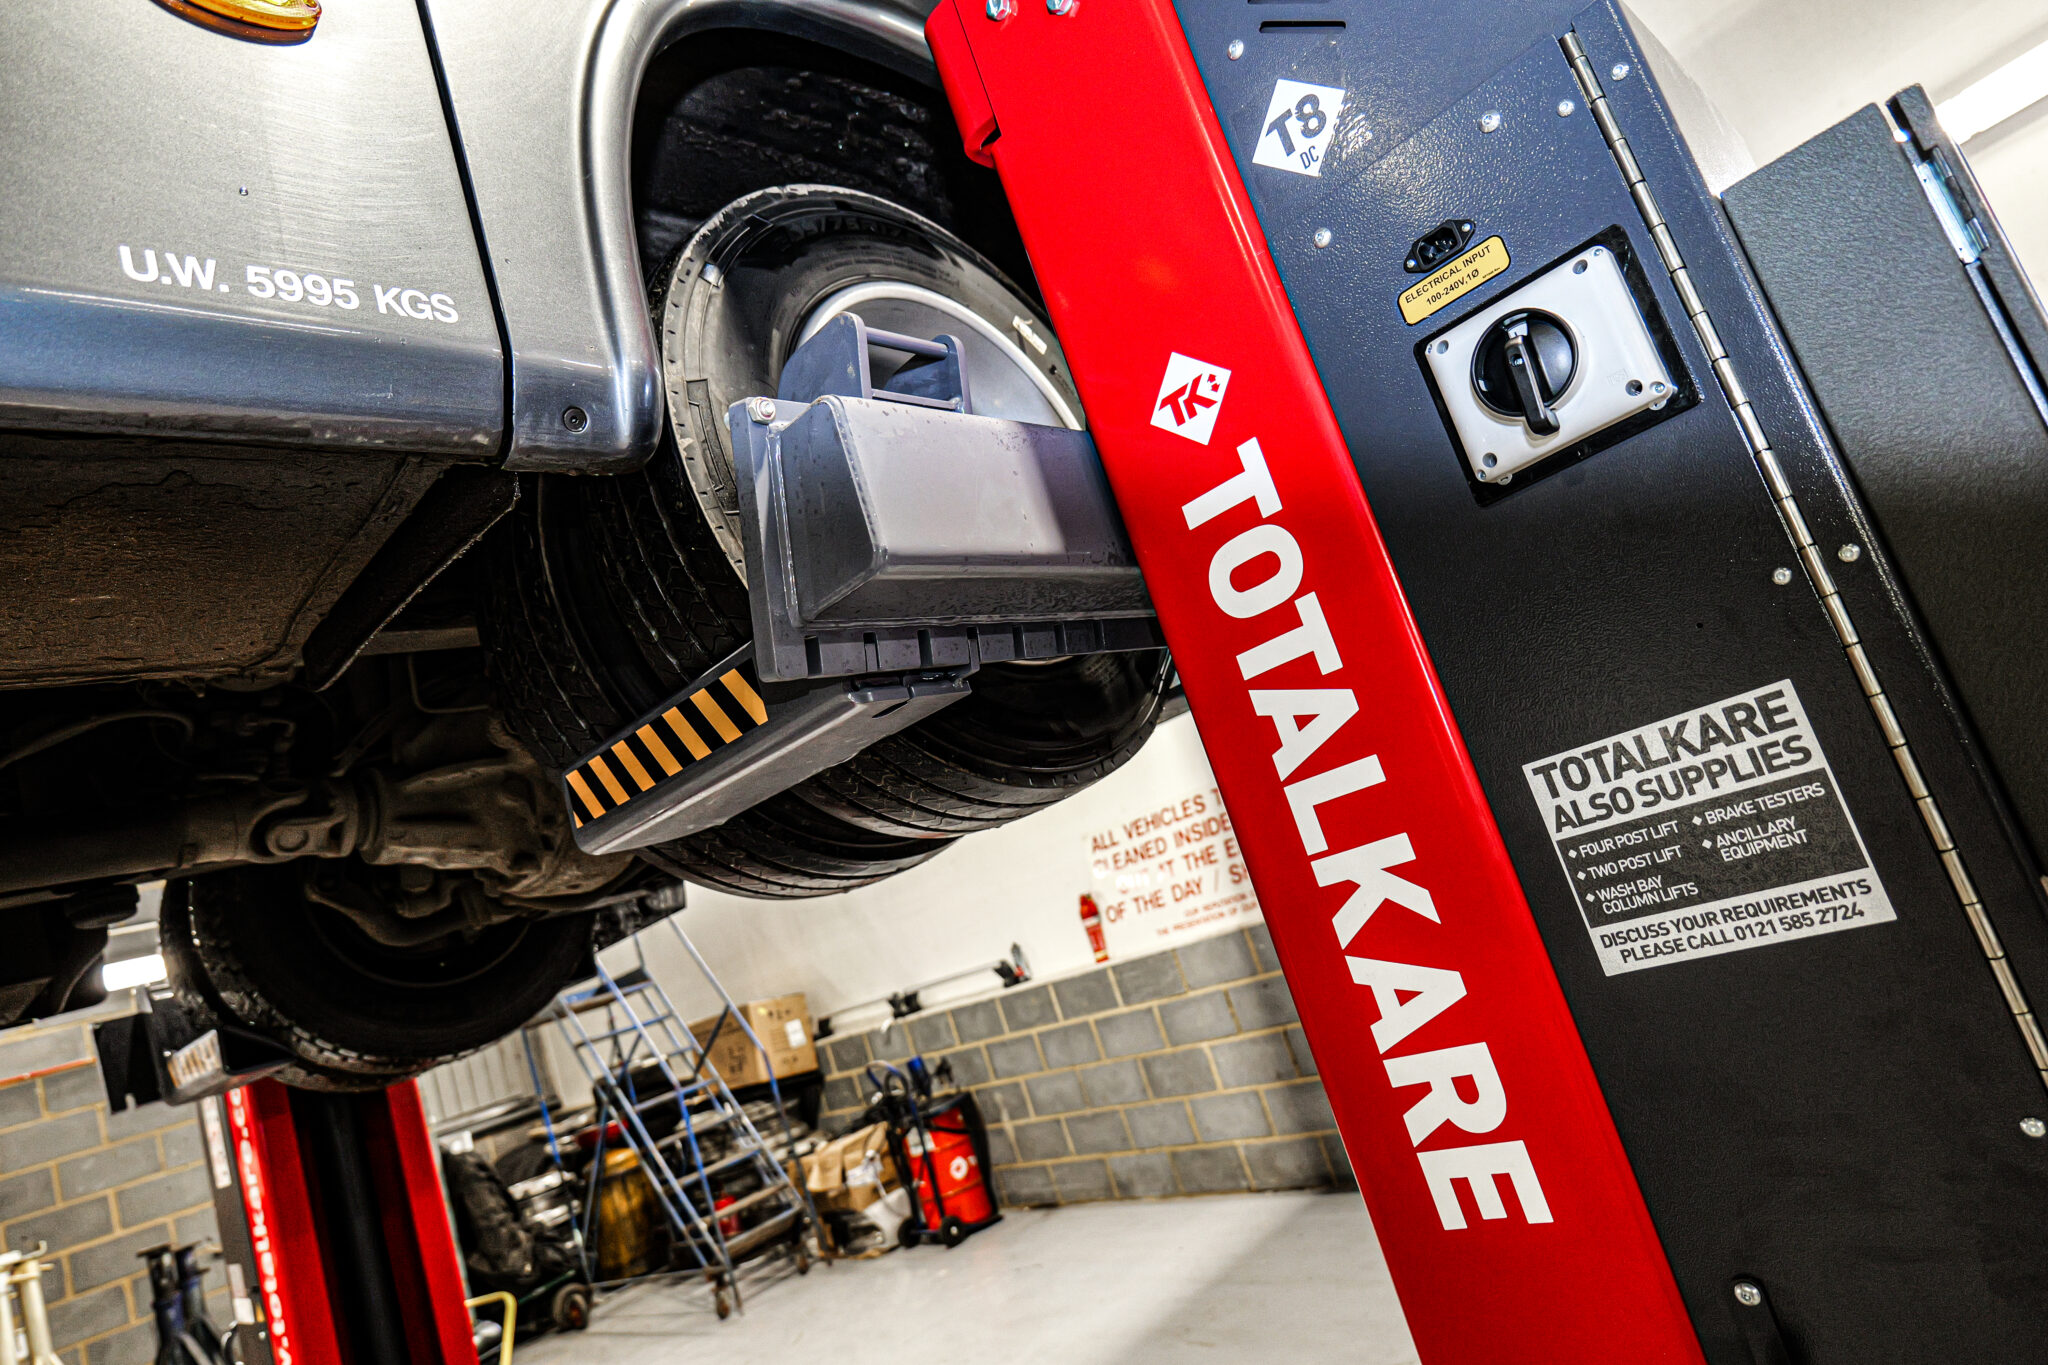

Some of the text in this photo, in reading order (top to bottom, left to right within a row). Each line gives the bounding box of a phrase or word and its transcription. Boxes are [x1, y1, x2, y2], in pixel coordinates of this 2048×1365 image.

[1265, 94, 1326, 157] T8
[1300, 146, 1319, 169] DC
[118, 245, 459, 324] U.W. 5995 KGS
[1405, 245, 1491, 304] ELECTRICAL INPUT
[1532, 688, 1799, 800] TOTALKARE
[1555, 734, 1813, 834] ALSO SUPPLIES
[1704, 782, 1826, 825] BRAKE TESTERS
[1092, 829, 1119, 853] ALL
[1122, 794, 1206, 840] VEHICLES
[1173, 811, 1232, 848] INSIDE
[1182, 436, 1554, 1231] TOTALKARE
[1578, 820, 1680, 858] FOUR POST LIFT
[1715, 815, 1797, 849] ANCILLARY
[1720, 829, 1808, 862] EQUIPMENT
[1182, 844, 1218, 871] THE
[1587, 845, 1682, 880] TWO POST LIFT
[1105, 901, 1126, 923] OF
[1133, 888, 1166, 914] THE
[1170, 876, 1204, 903] DAY
[1595, 875, 1664, 901] WASH BAY
[1602, 882, 1699, 915] COLUMN LIFTS
[1599, 878, 1872, 949] DISCUSS YOUR REQUIREMENTS
[1619, 901, 1865, 964] PLEASE CALL 0121 585 2724
